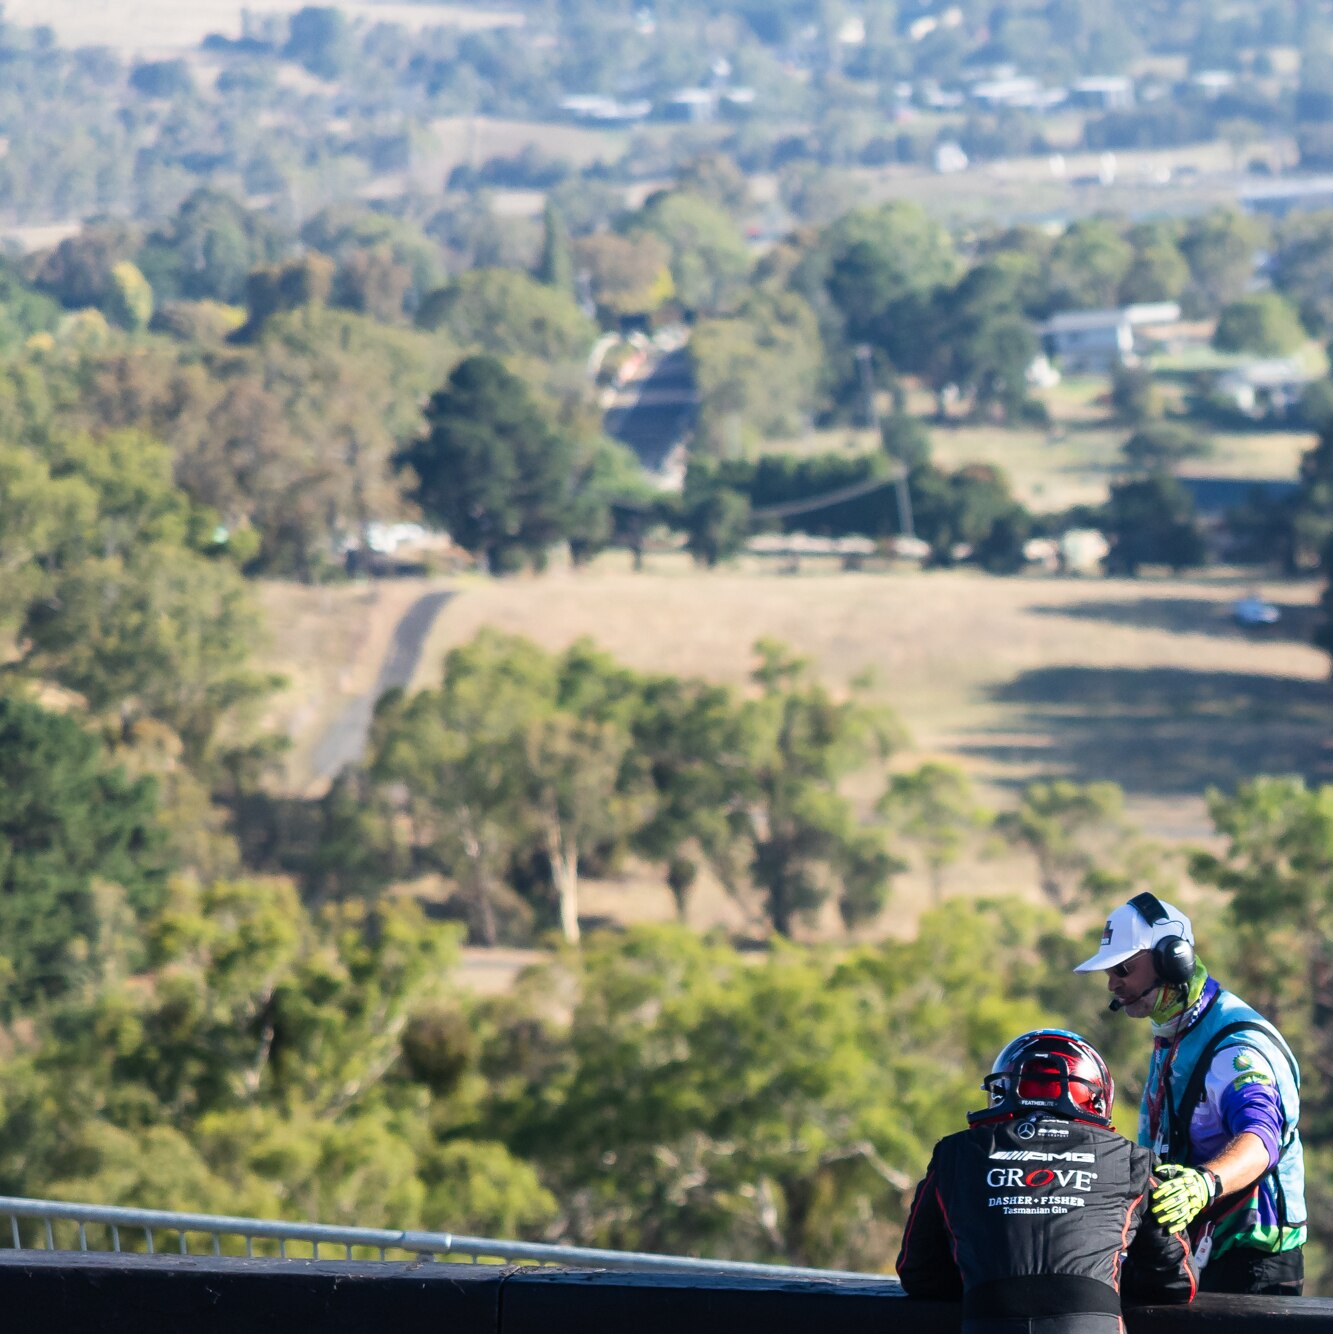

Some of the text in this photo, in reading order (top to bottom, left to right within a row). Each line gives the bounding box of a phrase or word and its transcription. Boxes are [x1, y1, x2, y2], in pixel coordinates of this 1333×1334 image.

[1015, 1151, 1095, 1163] AMG
[989, 1196, 1032, 1207] DASHER
[1041, 1196, 1085, 1207] FISHER
[1003, 1205, 1068, 1215] Tasmanian Gin
